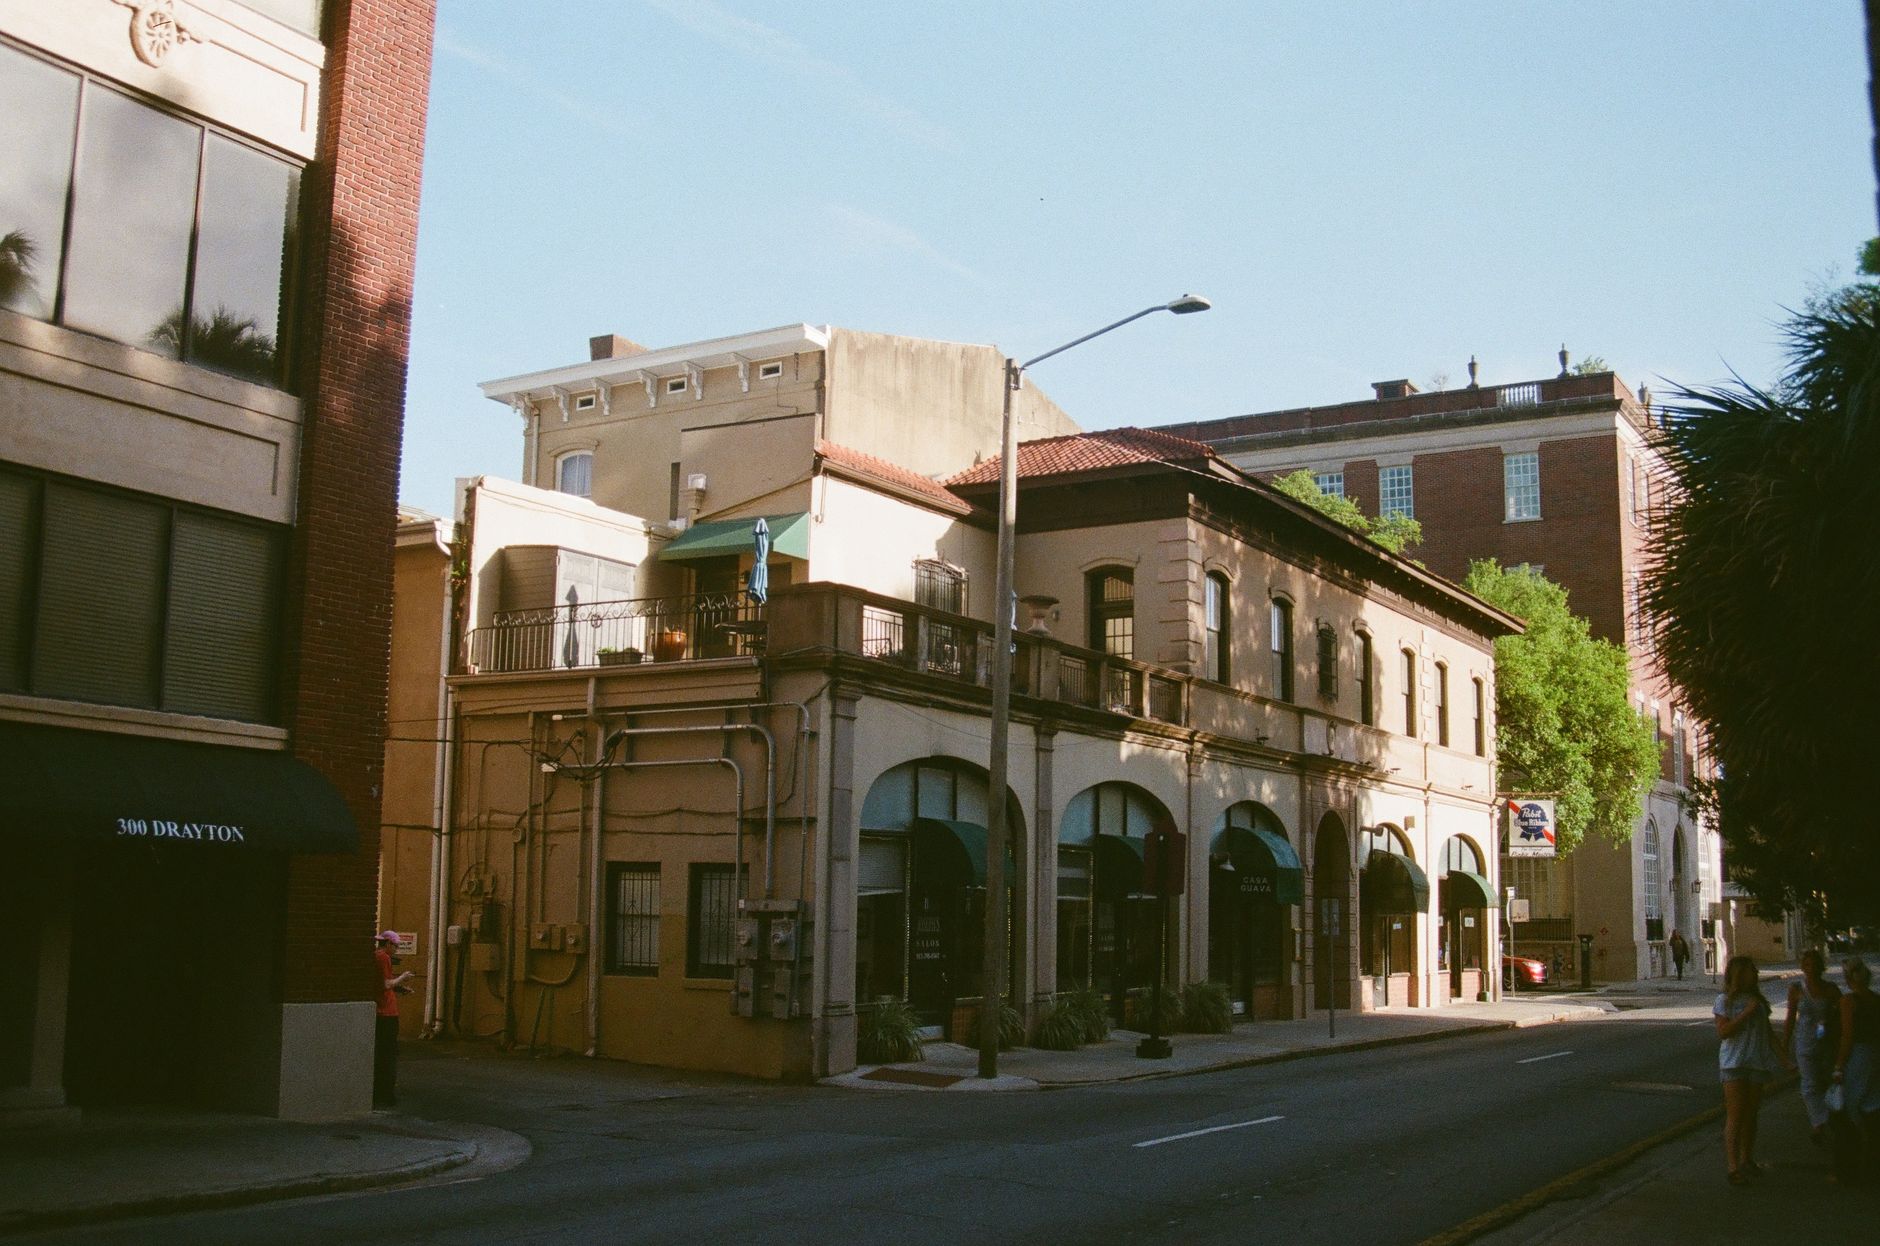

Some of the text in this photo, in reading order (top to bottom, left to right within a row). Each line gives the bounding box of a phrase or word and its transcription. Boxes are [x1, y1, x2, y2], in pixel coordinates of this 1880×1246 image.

[1521, 807, 1542, 818] Pabst
[116, 818, 245, 842] 300 DRAYTON
[1242, 876, 1268, 884] CASA
[1240, 884, 1272, 893] GUAVA
